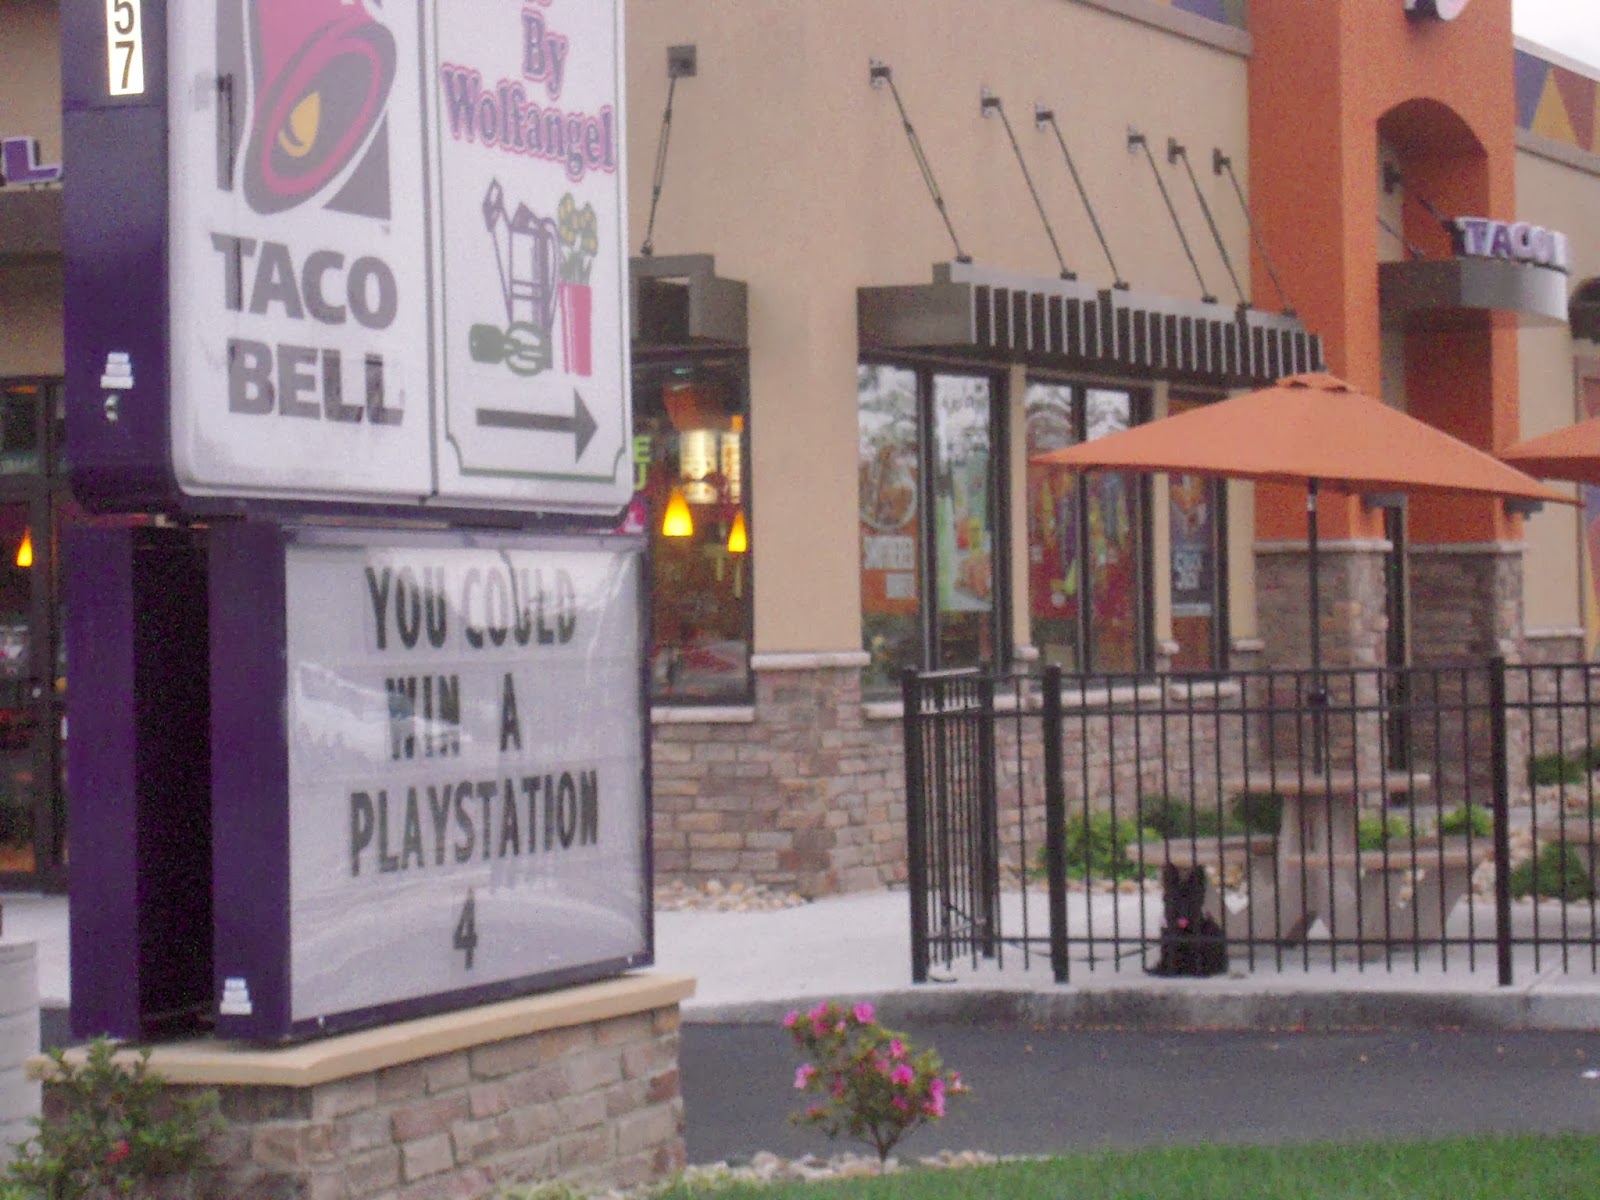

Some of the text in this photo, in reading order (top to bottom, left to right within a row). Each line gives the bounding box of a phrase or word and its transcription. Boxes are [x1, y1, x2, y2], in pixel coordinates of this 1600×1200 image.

[521, 7, 569, 101] By
[441, 62, 616, 181] Wolfangel
[209, 231, 399, 331] TACO
[226, 337, 405, 426] BELL
[364, 566, 578, 651] YOU COULD
[384, 672, 522, 760] WIN A
[350, 769, 599, 876] PLAYSTATION
[452, 887, 478, 970] 4
